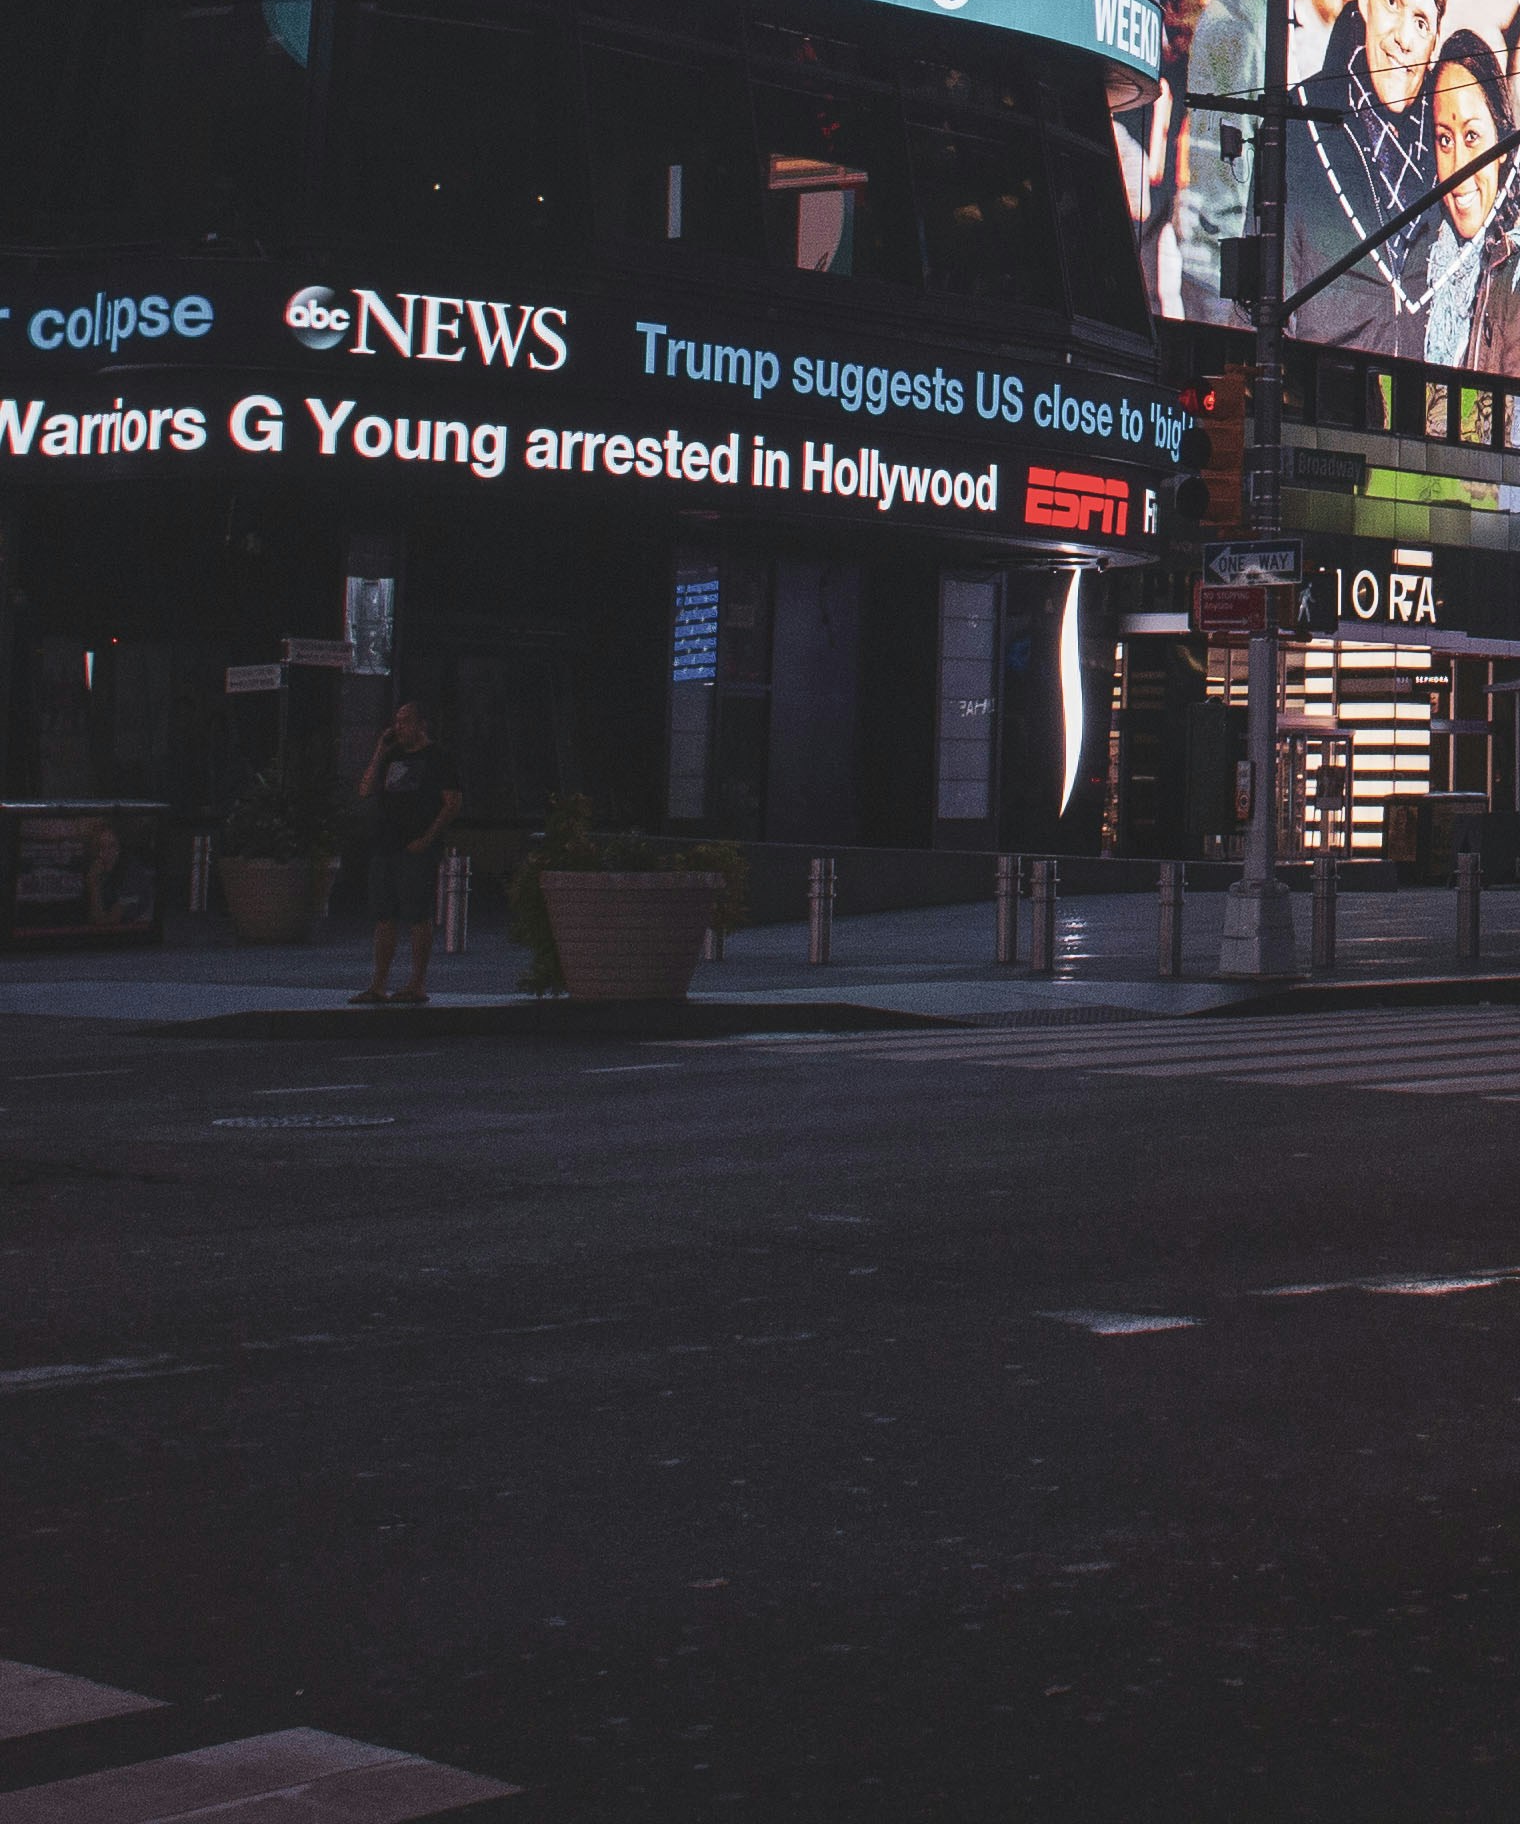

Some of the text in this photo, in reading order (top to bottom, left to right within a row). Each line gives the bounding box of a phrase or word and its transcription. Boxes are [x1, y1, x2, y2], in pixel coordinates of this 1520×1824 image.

[286, 287, 568, 371] abc NEWS
[636, 321, 780, 399] Trump
[792, 356, 964, 415] suggests
[975, 371, 1024, 424] US
[1033, 383, 1113, 437] close
[1120, 398, 1143, 443] to
[0, 397, 207, 456] Warriors
[229, 394, 284, 453] G
[304, 398, 507, 478] Young
[524, 428, 739, 486] arrested
[752, 435, 790, 489] in
[802, 440, 998, 512] Hollywood
[1025, 466, 1129, 536] ESPN
[1218, 552, 1289, 574] ONE WAY
